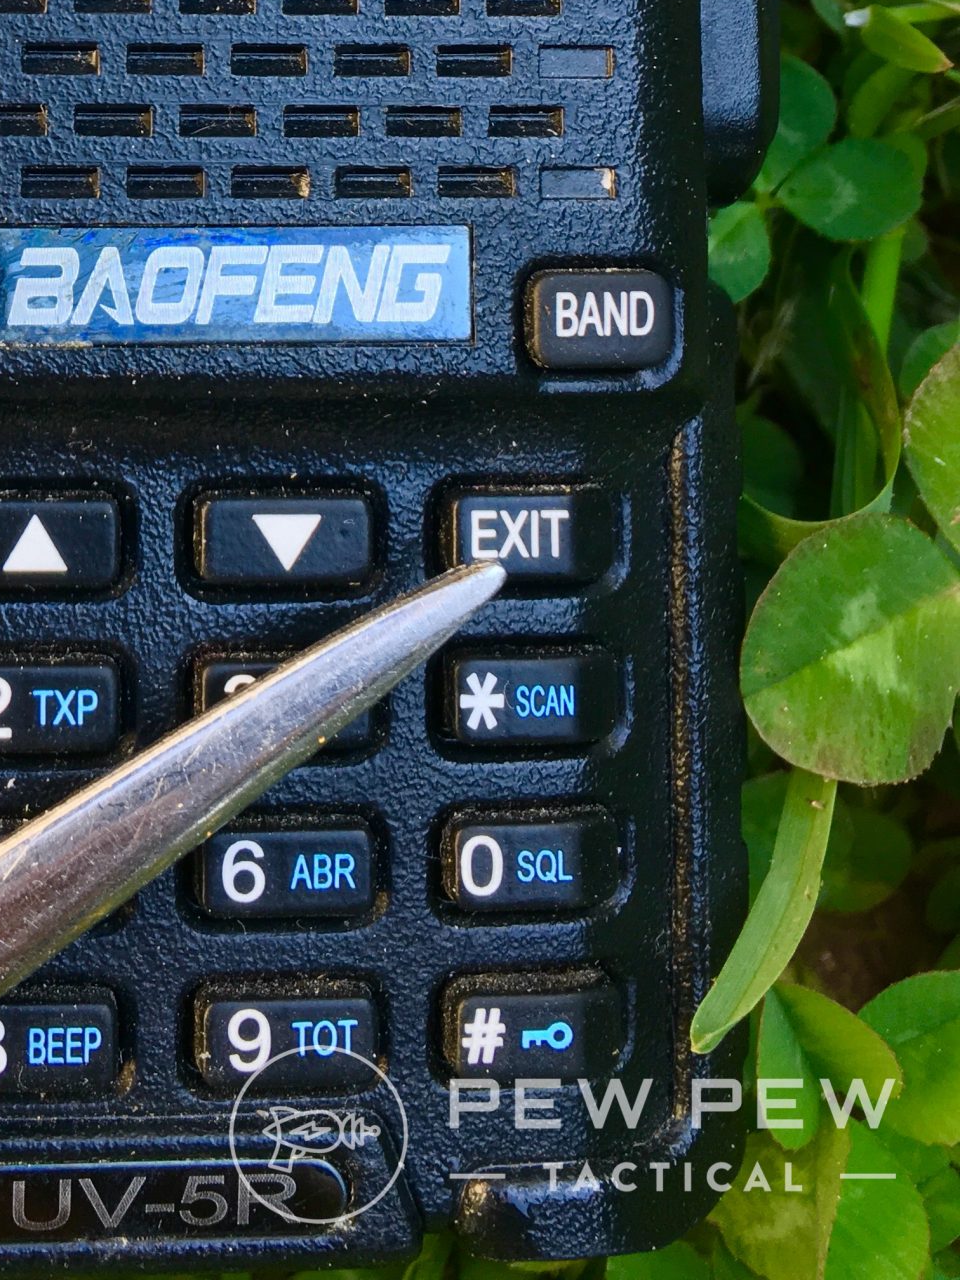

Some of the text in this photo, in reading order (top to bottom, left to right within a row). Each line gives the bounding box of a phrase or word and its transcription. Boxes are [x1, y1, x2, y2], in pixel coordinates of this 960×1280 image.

[6, 245, 450, 326] BAOFENG
[555, 290, 655, 338] BAND
[470, 509, 570, 559] EXIT
[32, 689, 99, 726] TXP
[515, 684, 575, 718] SCAN
[221, 840, 356, 903] 6 ABR
[460, 835, 574, 897] 0 SQL
[28, 1026, 102, 1065] BEEP
[227, 1009, 359, 1073] 9 TOT
[461, 1008, 506, 1065] #
[11, 1173, 300, 1231] UV-5R
